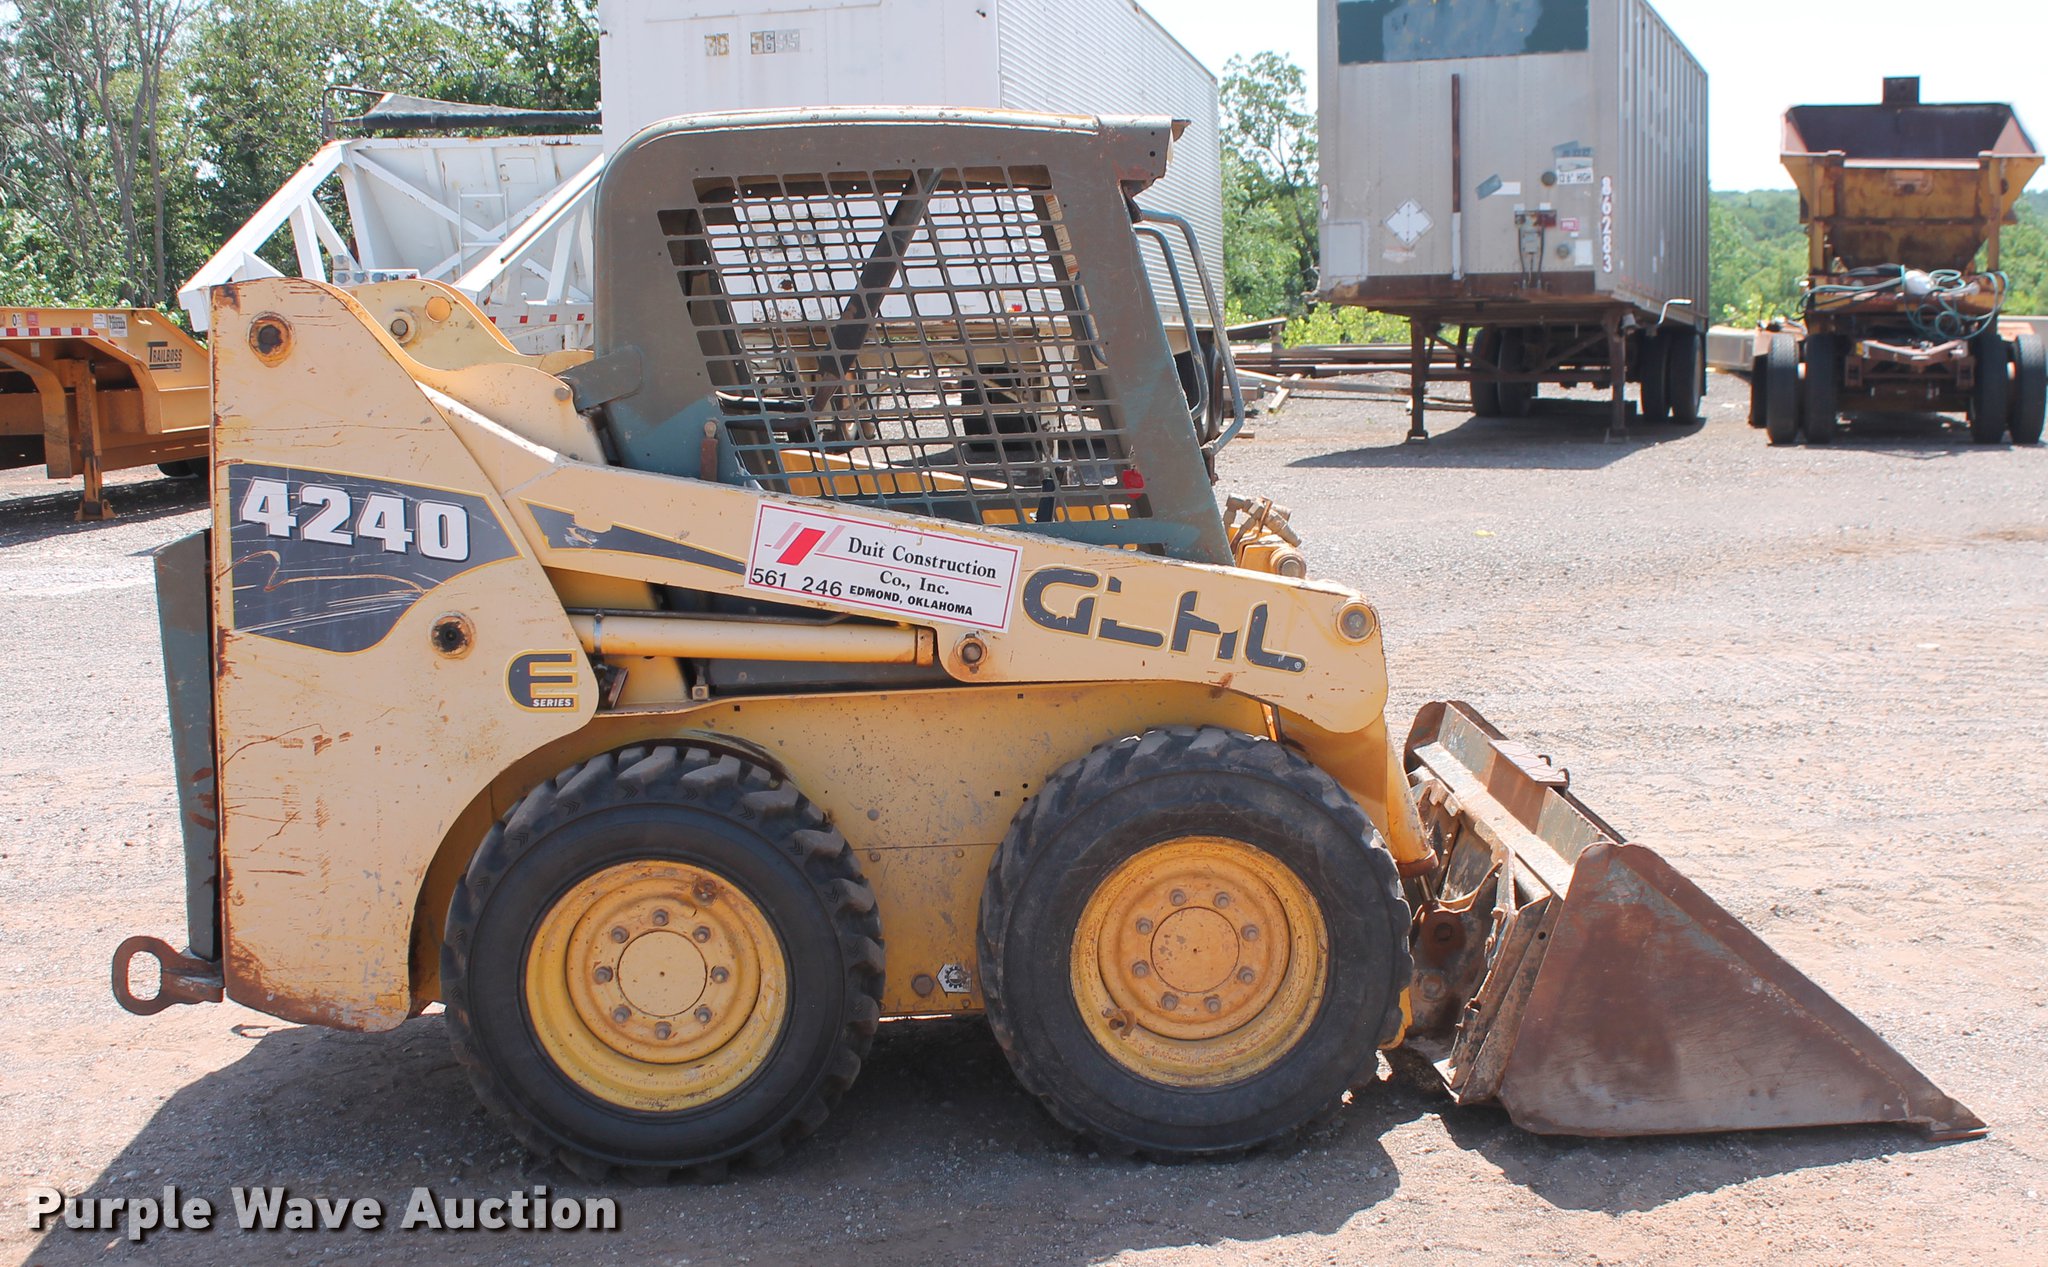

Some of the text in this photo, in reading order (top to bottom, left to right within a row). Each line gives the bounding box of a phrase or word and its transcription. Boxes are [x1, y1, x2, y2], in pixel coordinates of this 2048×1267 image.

[1601, 176, 1612, 273] 86283
[148, 341, 182, 363] TRAILBOSS
[240, 478, 471, 561] 4240
[847, 537, 997, 579] Duit Construction
[752, 568, 842, 597] 561 246
[879, 570, 950, 595] Co., Inc.
[849, 585, 973, 616] EDMOND, OKLAHOMA
[533, 699, 572, 707] SERIES
